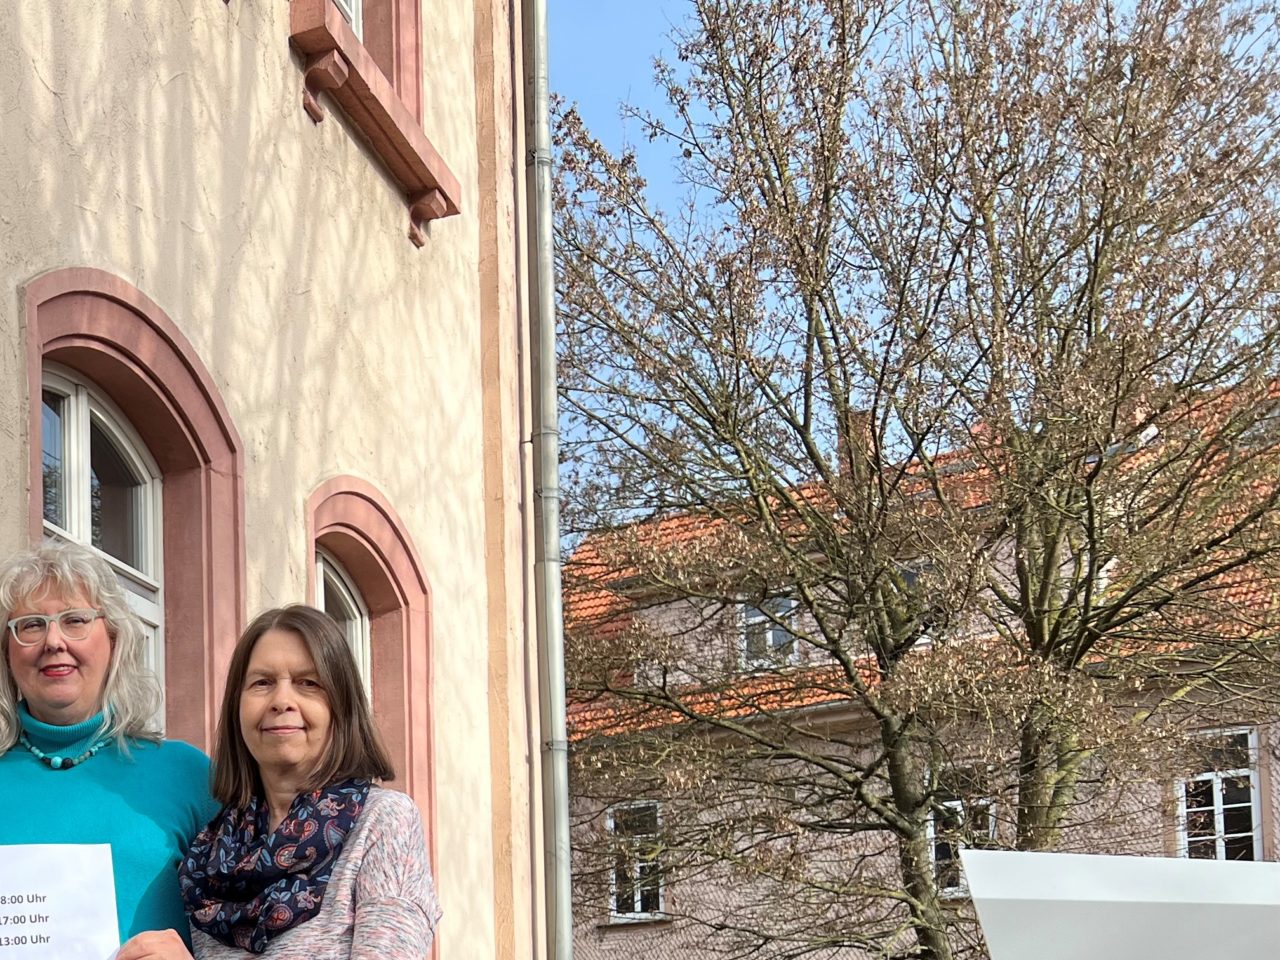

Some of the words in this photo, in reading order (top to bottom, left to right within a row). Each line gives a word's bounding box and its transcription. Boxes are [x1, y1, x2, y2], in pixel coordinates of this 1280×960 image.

[27, 894, 47, 904] Uhr
[29, 914, 49, 923] Uhr
[30, 935, 51, 944] Uhr
